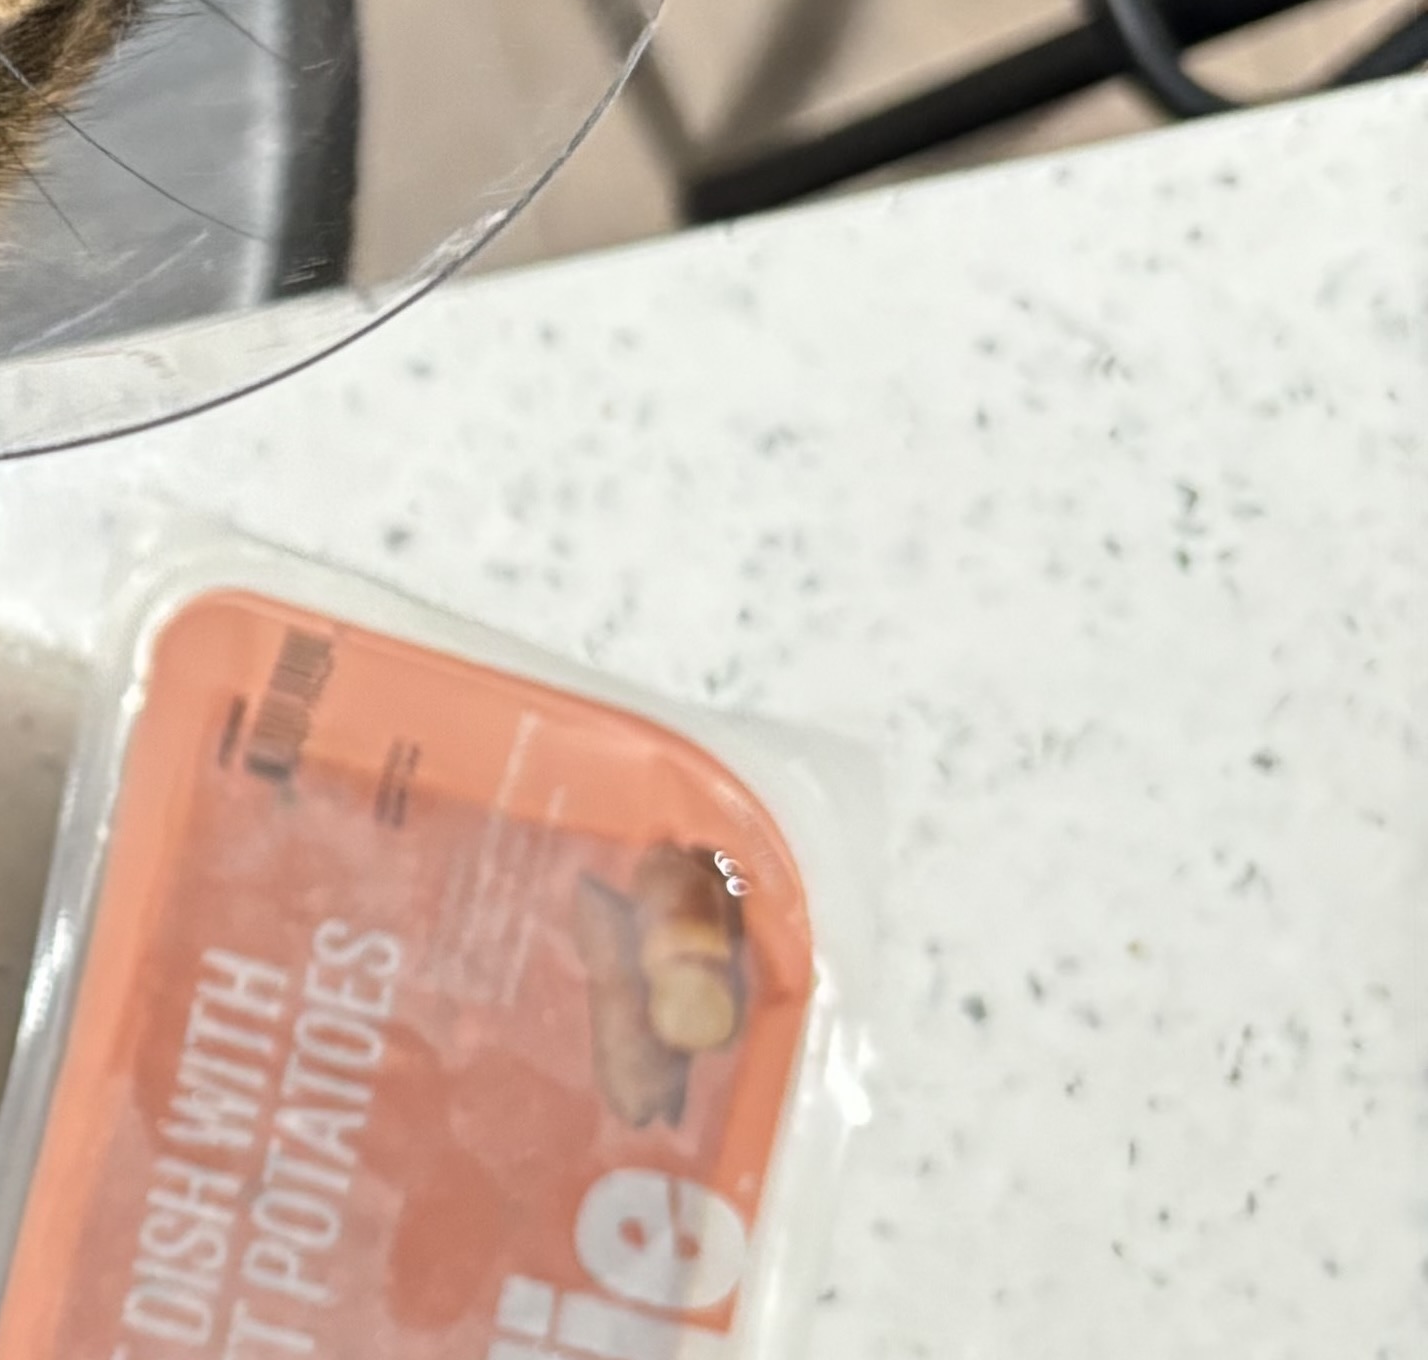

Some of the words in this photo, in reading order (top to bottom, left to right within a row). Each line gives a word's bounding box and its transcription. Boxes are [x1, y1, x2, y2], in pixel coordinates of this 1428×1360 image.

[156, 946, 288, 1149] WITH
[242, 916, 402, 1308] POTATOES
[120, 1156, 241, 1347] DISH
